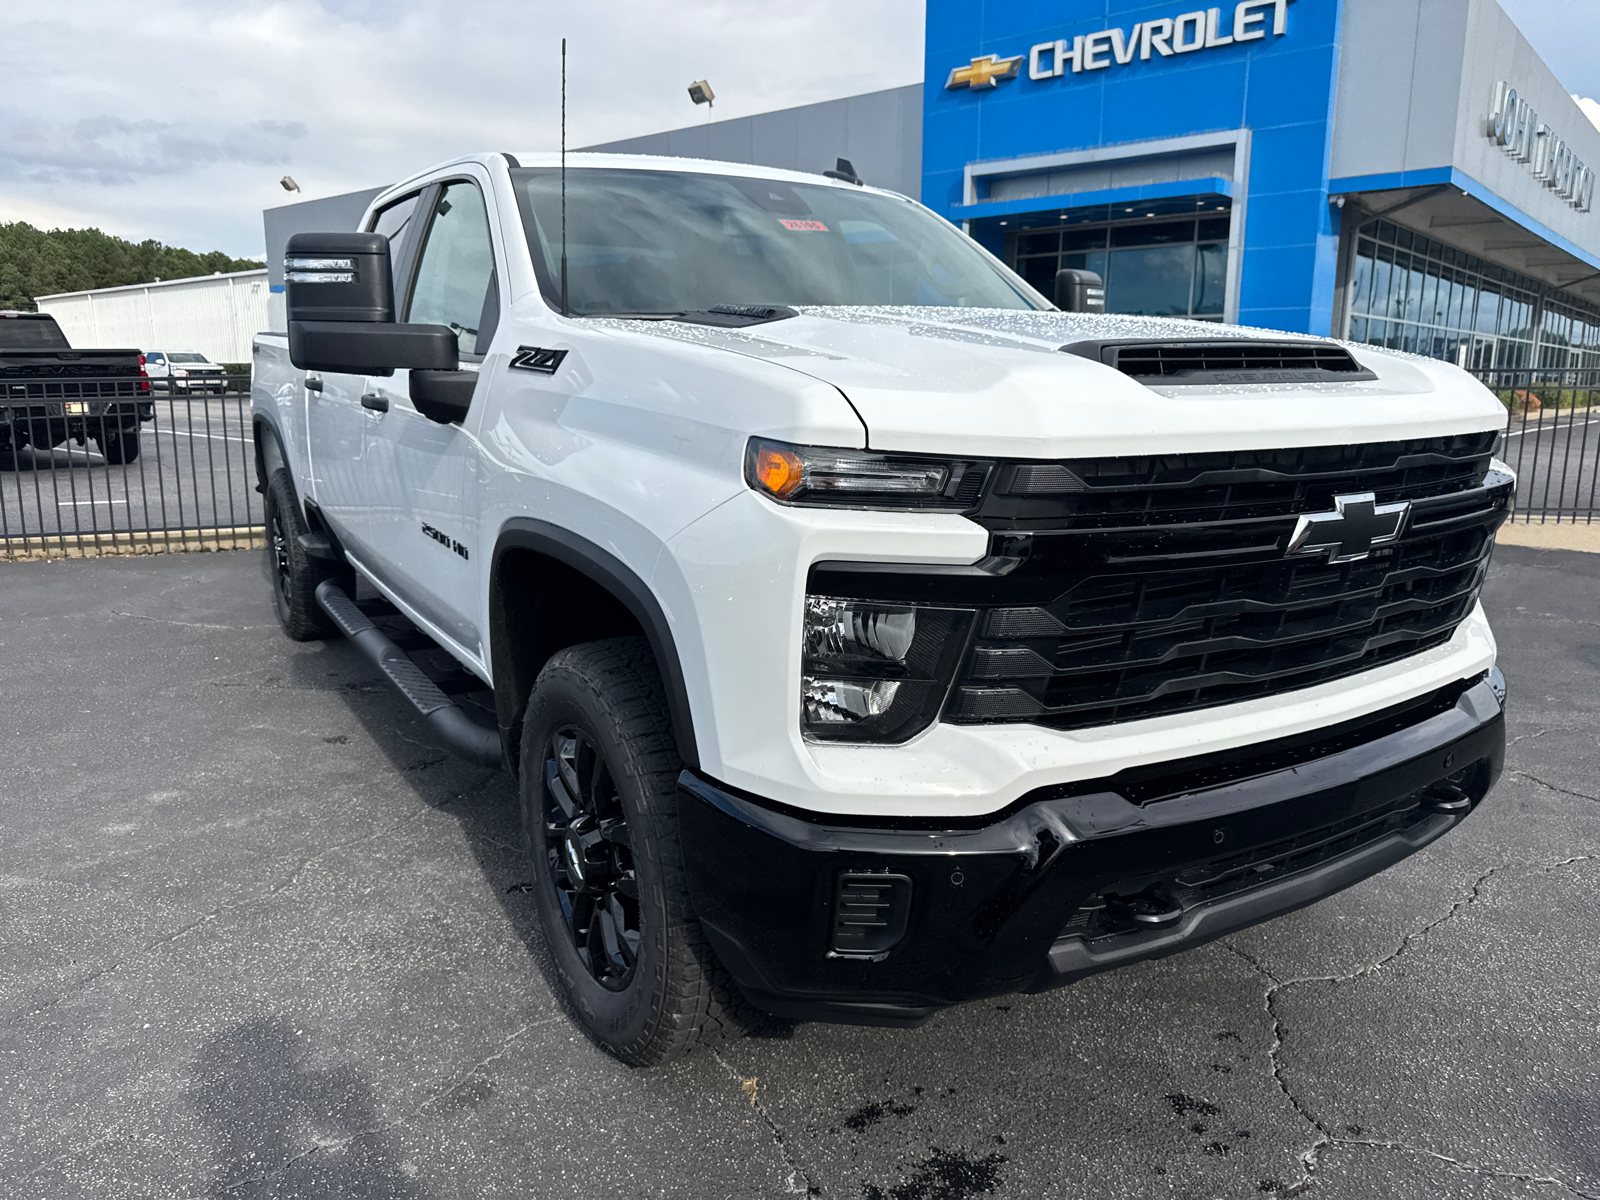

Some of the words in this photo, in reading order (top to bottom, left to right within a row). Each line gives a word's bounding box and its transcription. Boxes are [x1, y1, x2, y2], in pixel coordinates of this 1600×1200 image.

[1028, 0, 1288, 80] CHEVROLET
[1487, 81, 1537, 163] JOHN
[508, 345, 569, 375] Z71
[1213, 373, 1322, 382] CHEVROLET
[422, 521, 450, 548] 2500
[453, 540, 468, 560] HD
